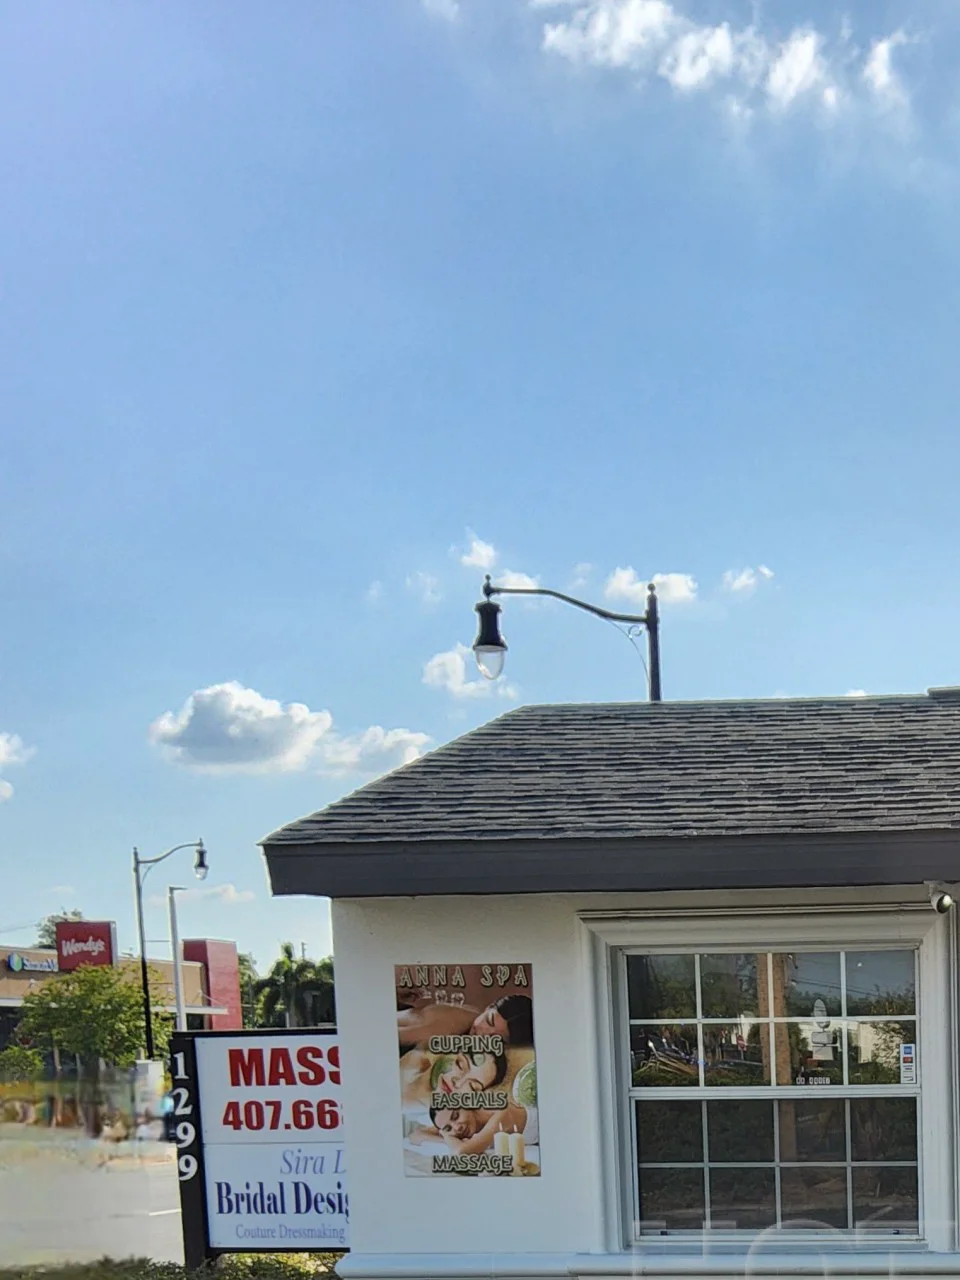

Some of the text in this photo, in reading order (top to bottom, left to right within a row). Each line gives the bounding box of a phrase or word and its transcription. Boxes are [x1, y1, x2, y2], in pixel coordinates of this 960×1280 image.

[399, 964, 528, 988] ANNA SPA
[429, 1035, 504, 1056] CUPPING
[431, 1092, 508, 1110] FASCIALS
[223, 1099, 343, 1131] 407.66
[280, 1148, 325, 1174] Sira
[432, 1154, 513, 1174] MASSAGE
[215, 1181, 286, 1215] Bridal
[236, 1222, 346, 1244] Couture Dressmaking
